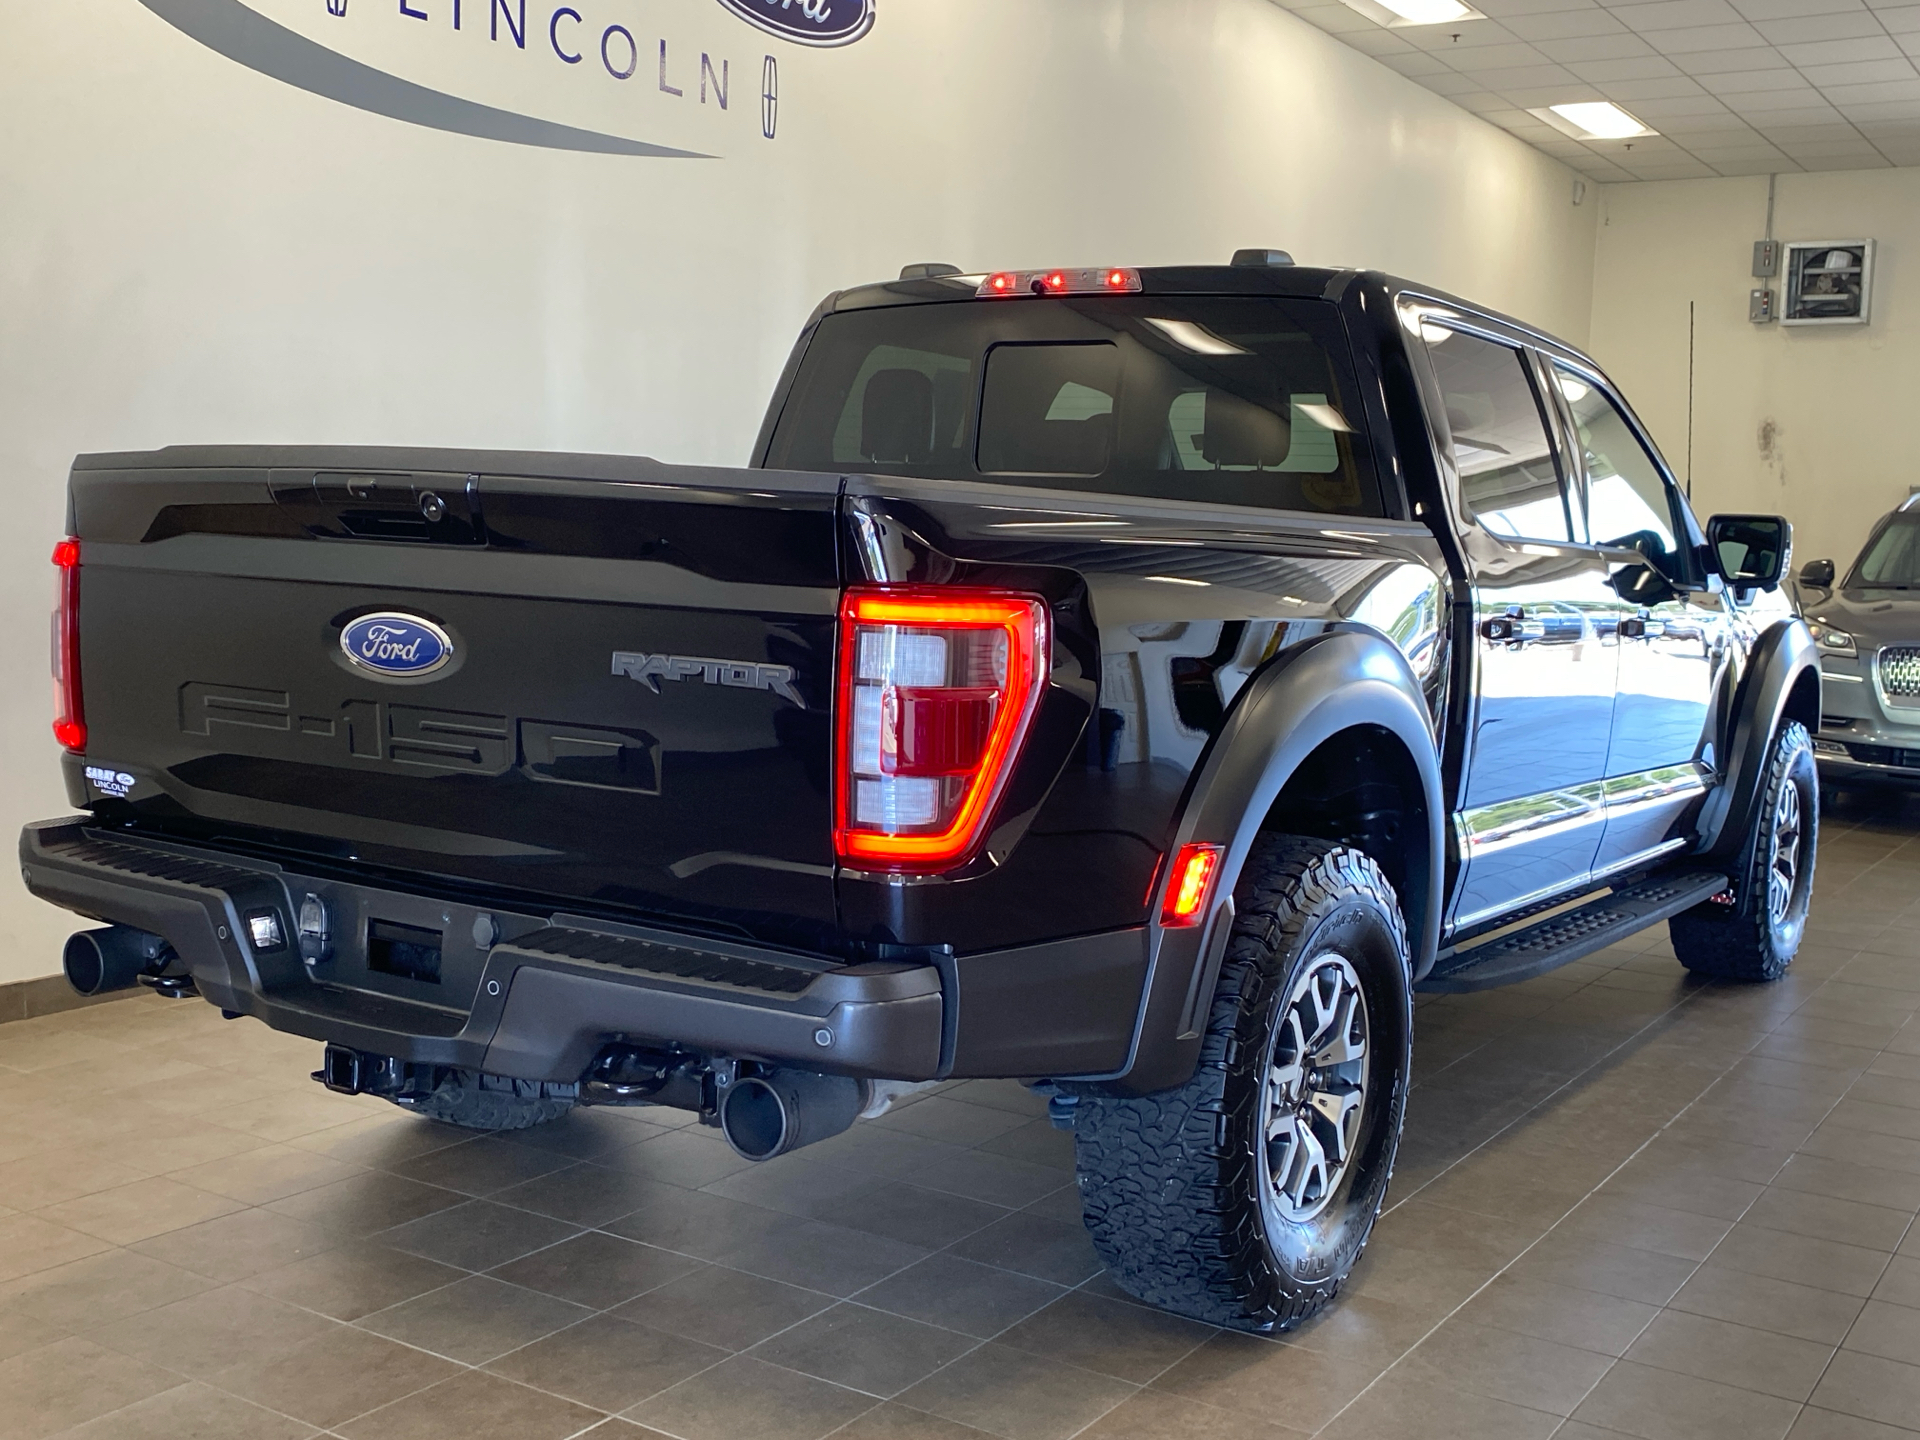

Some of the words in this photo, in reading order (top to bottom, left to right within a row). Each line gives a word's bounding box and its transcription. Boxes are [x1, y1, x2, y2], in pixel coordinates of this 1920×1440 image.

[400, 0, 728, 110] INCOLN
[362, 625, 421, 662] Ford
[611, 651, 809, 710] RAPTOR
[178, 680, 663, 796] F-150
[93, 779, 129, 793] LINCOLN
